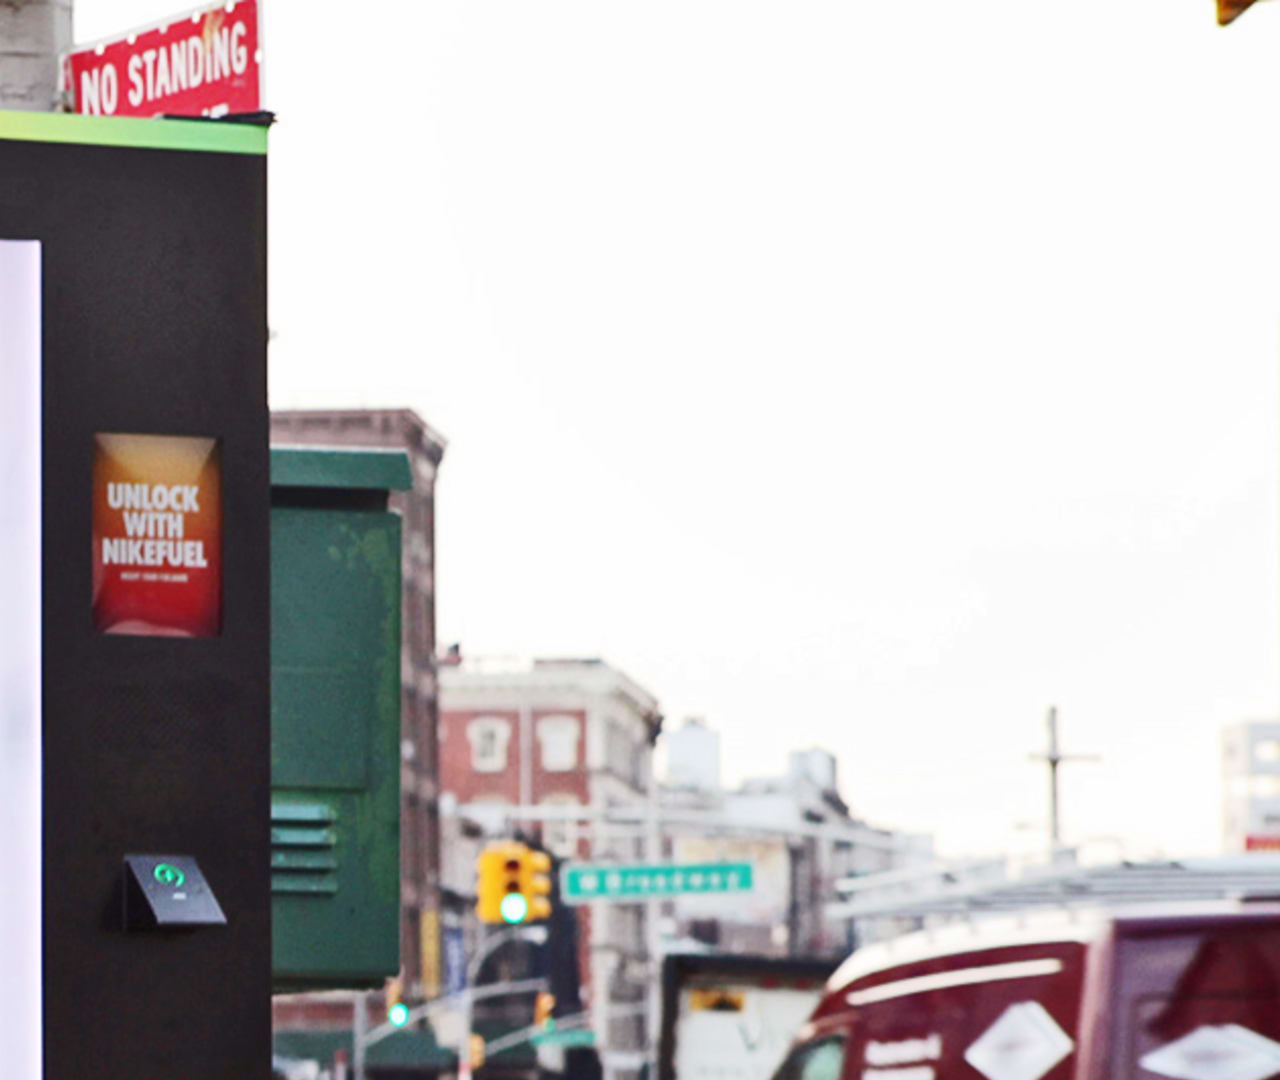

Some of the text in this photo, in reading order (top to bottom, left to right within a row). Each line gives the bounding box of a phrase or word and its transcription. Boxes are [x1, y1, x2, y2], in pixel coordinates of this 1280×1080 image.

[80, 21, 248, 117] NO STANDING
[107, 482, 200, 513] UNLOCK
[122, 511, 184, 538] WITH
[102, 538, 208, 568] NIKEFUEL
